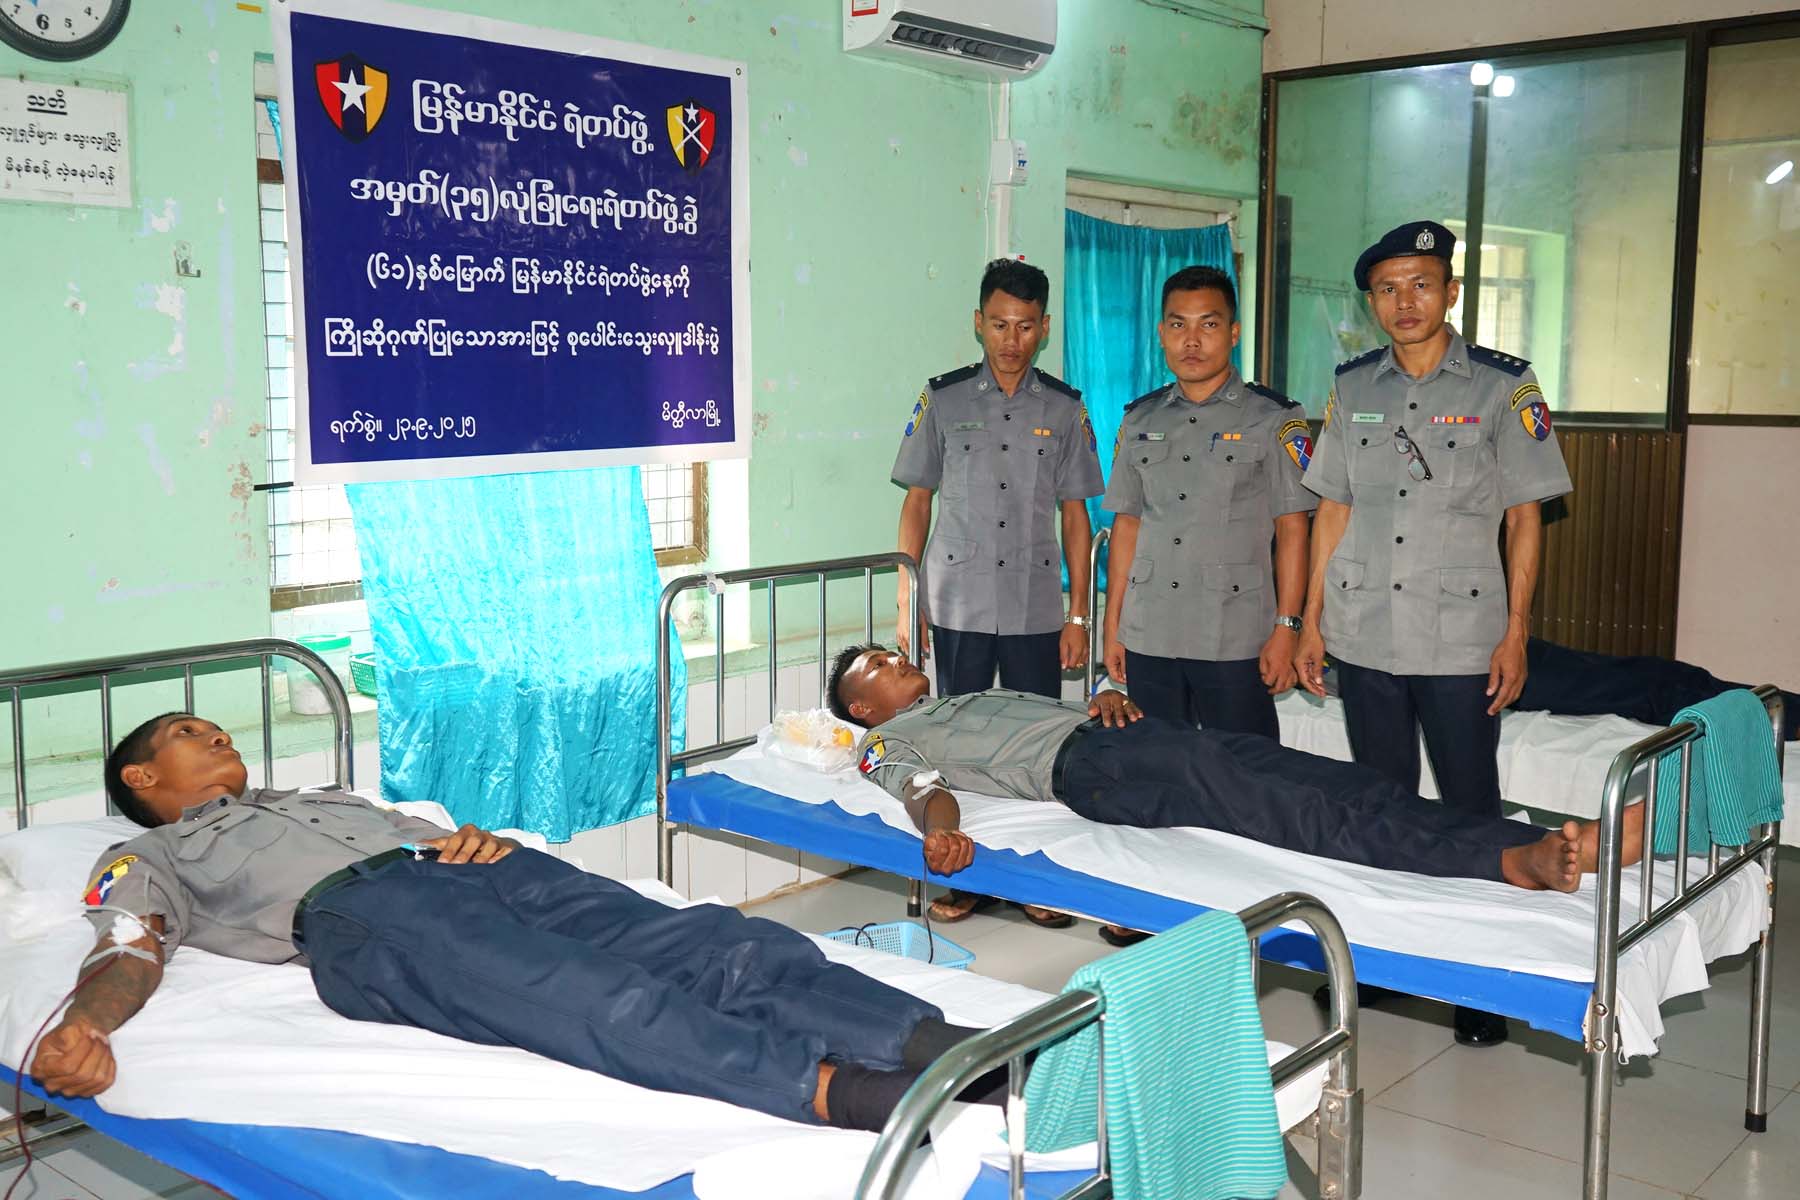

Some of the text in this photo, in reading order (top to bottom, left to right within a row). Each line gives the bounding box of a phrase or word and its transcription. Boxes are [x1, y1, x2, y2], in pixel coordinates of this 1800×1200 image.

[13, 4, 21, 14] 7
[84, 6, 92, 16] 4
[36, 14, 50, 30] 6
[64, 17, 73, 28] 5
[412, 79, 655, 155] မြန်မာနိုင်ငံ ရဲတပ်ဖွဲ့
[366, 251, 690, 298] (၆၁)နှစ်မြောက် မြန်မာနိုင်ငံရဲတပ်ဖွဲ့နေ့ကို
[324, 317, 720, 357] ကြိုဆိုဂုဏ်ပြုသောအားဖြင့် စုပေါင်းသွေးလှူဒါန်းပွဲ
